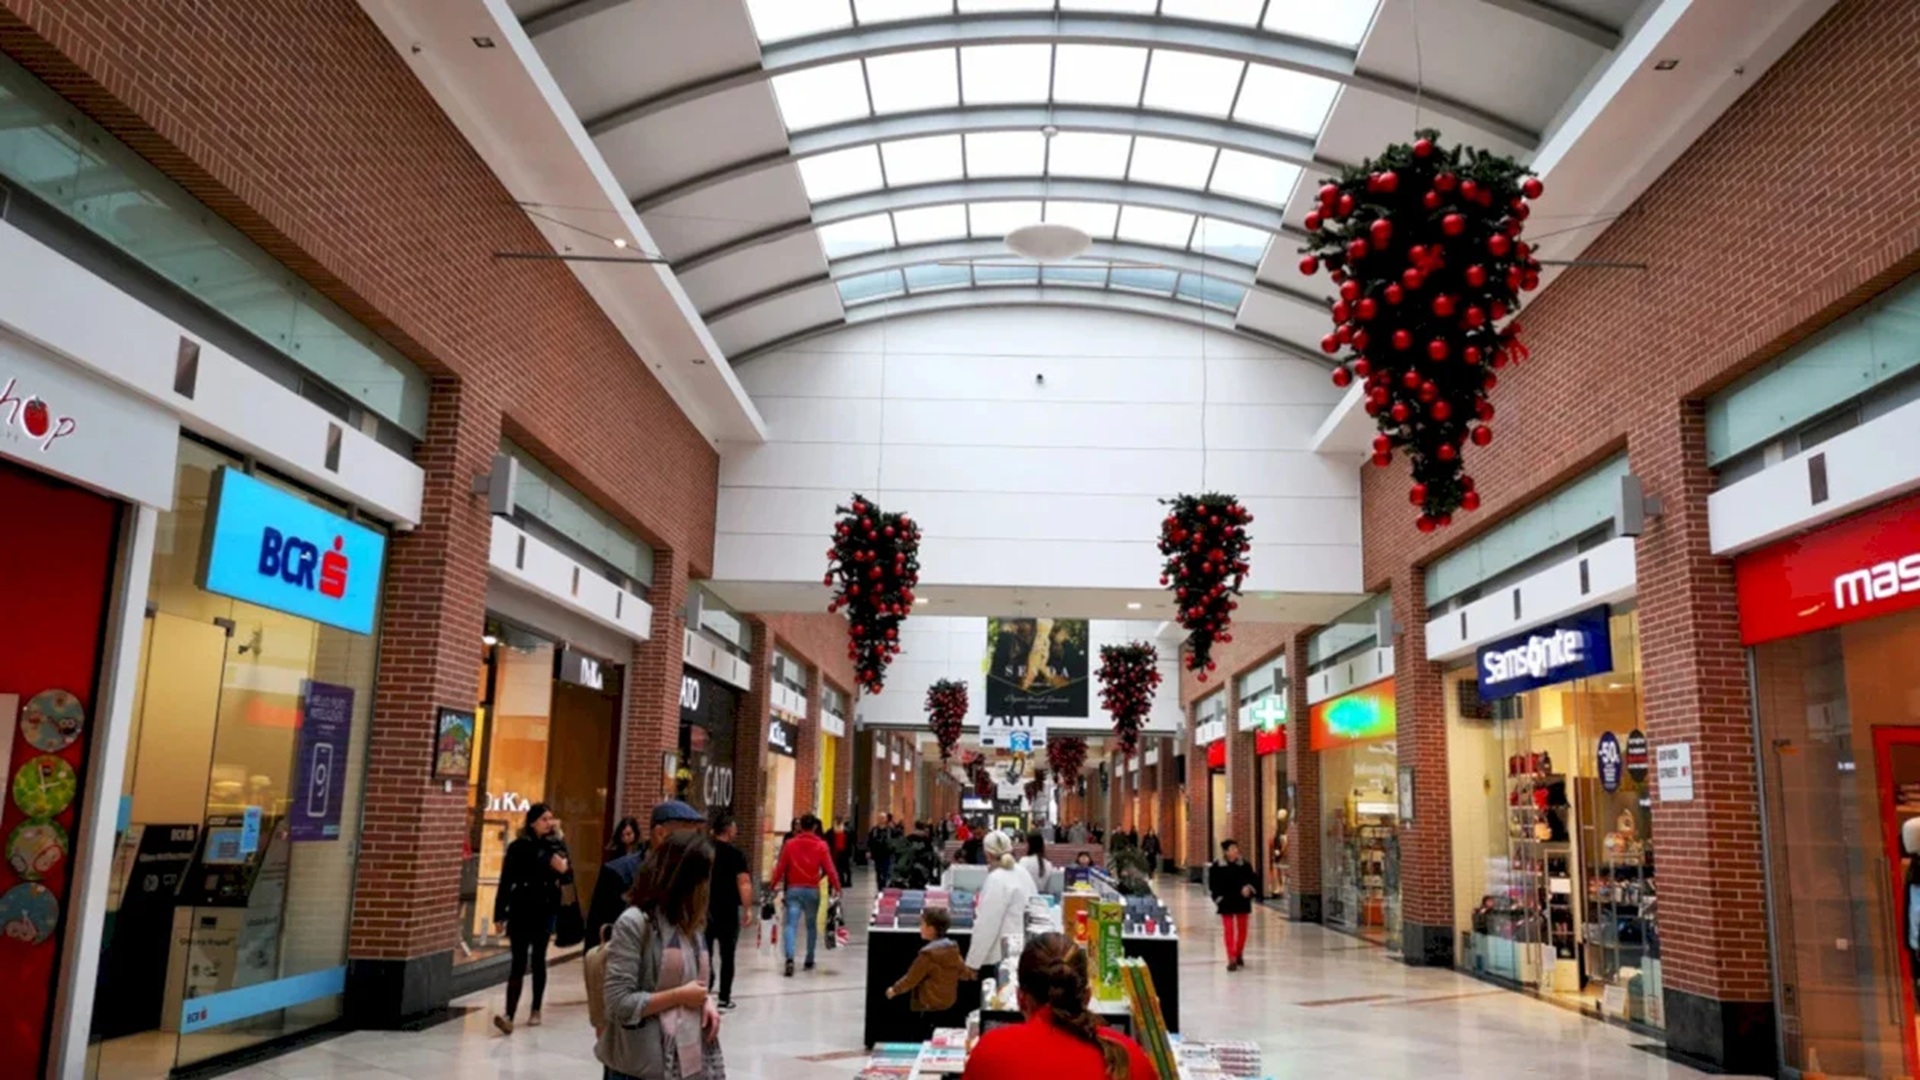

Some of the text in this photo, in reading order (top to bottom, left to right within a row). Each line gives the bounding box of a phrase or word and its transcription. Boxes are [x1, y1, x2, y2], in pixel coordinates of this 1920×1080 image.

[258, 526, 319, 591] BCR
[1834, 552, 1920, 609] mas
[1483, 629, 1584, 684] Samsonite
[703, 764, 733, 807] CATO
